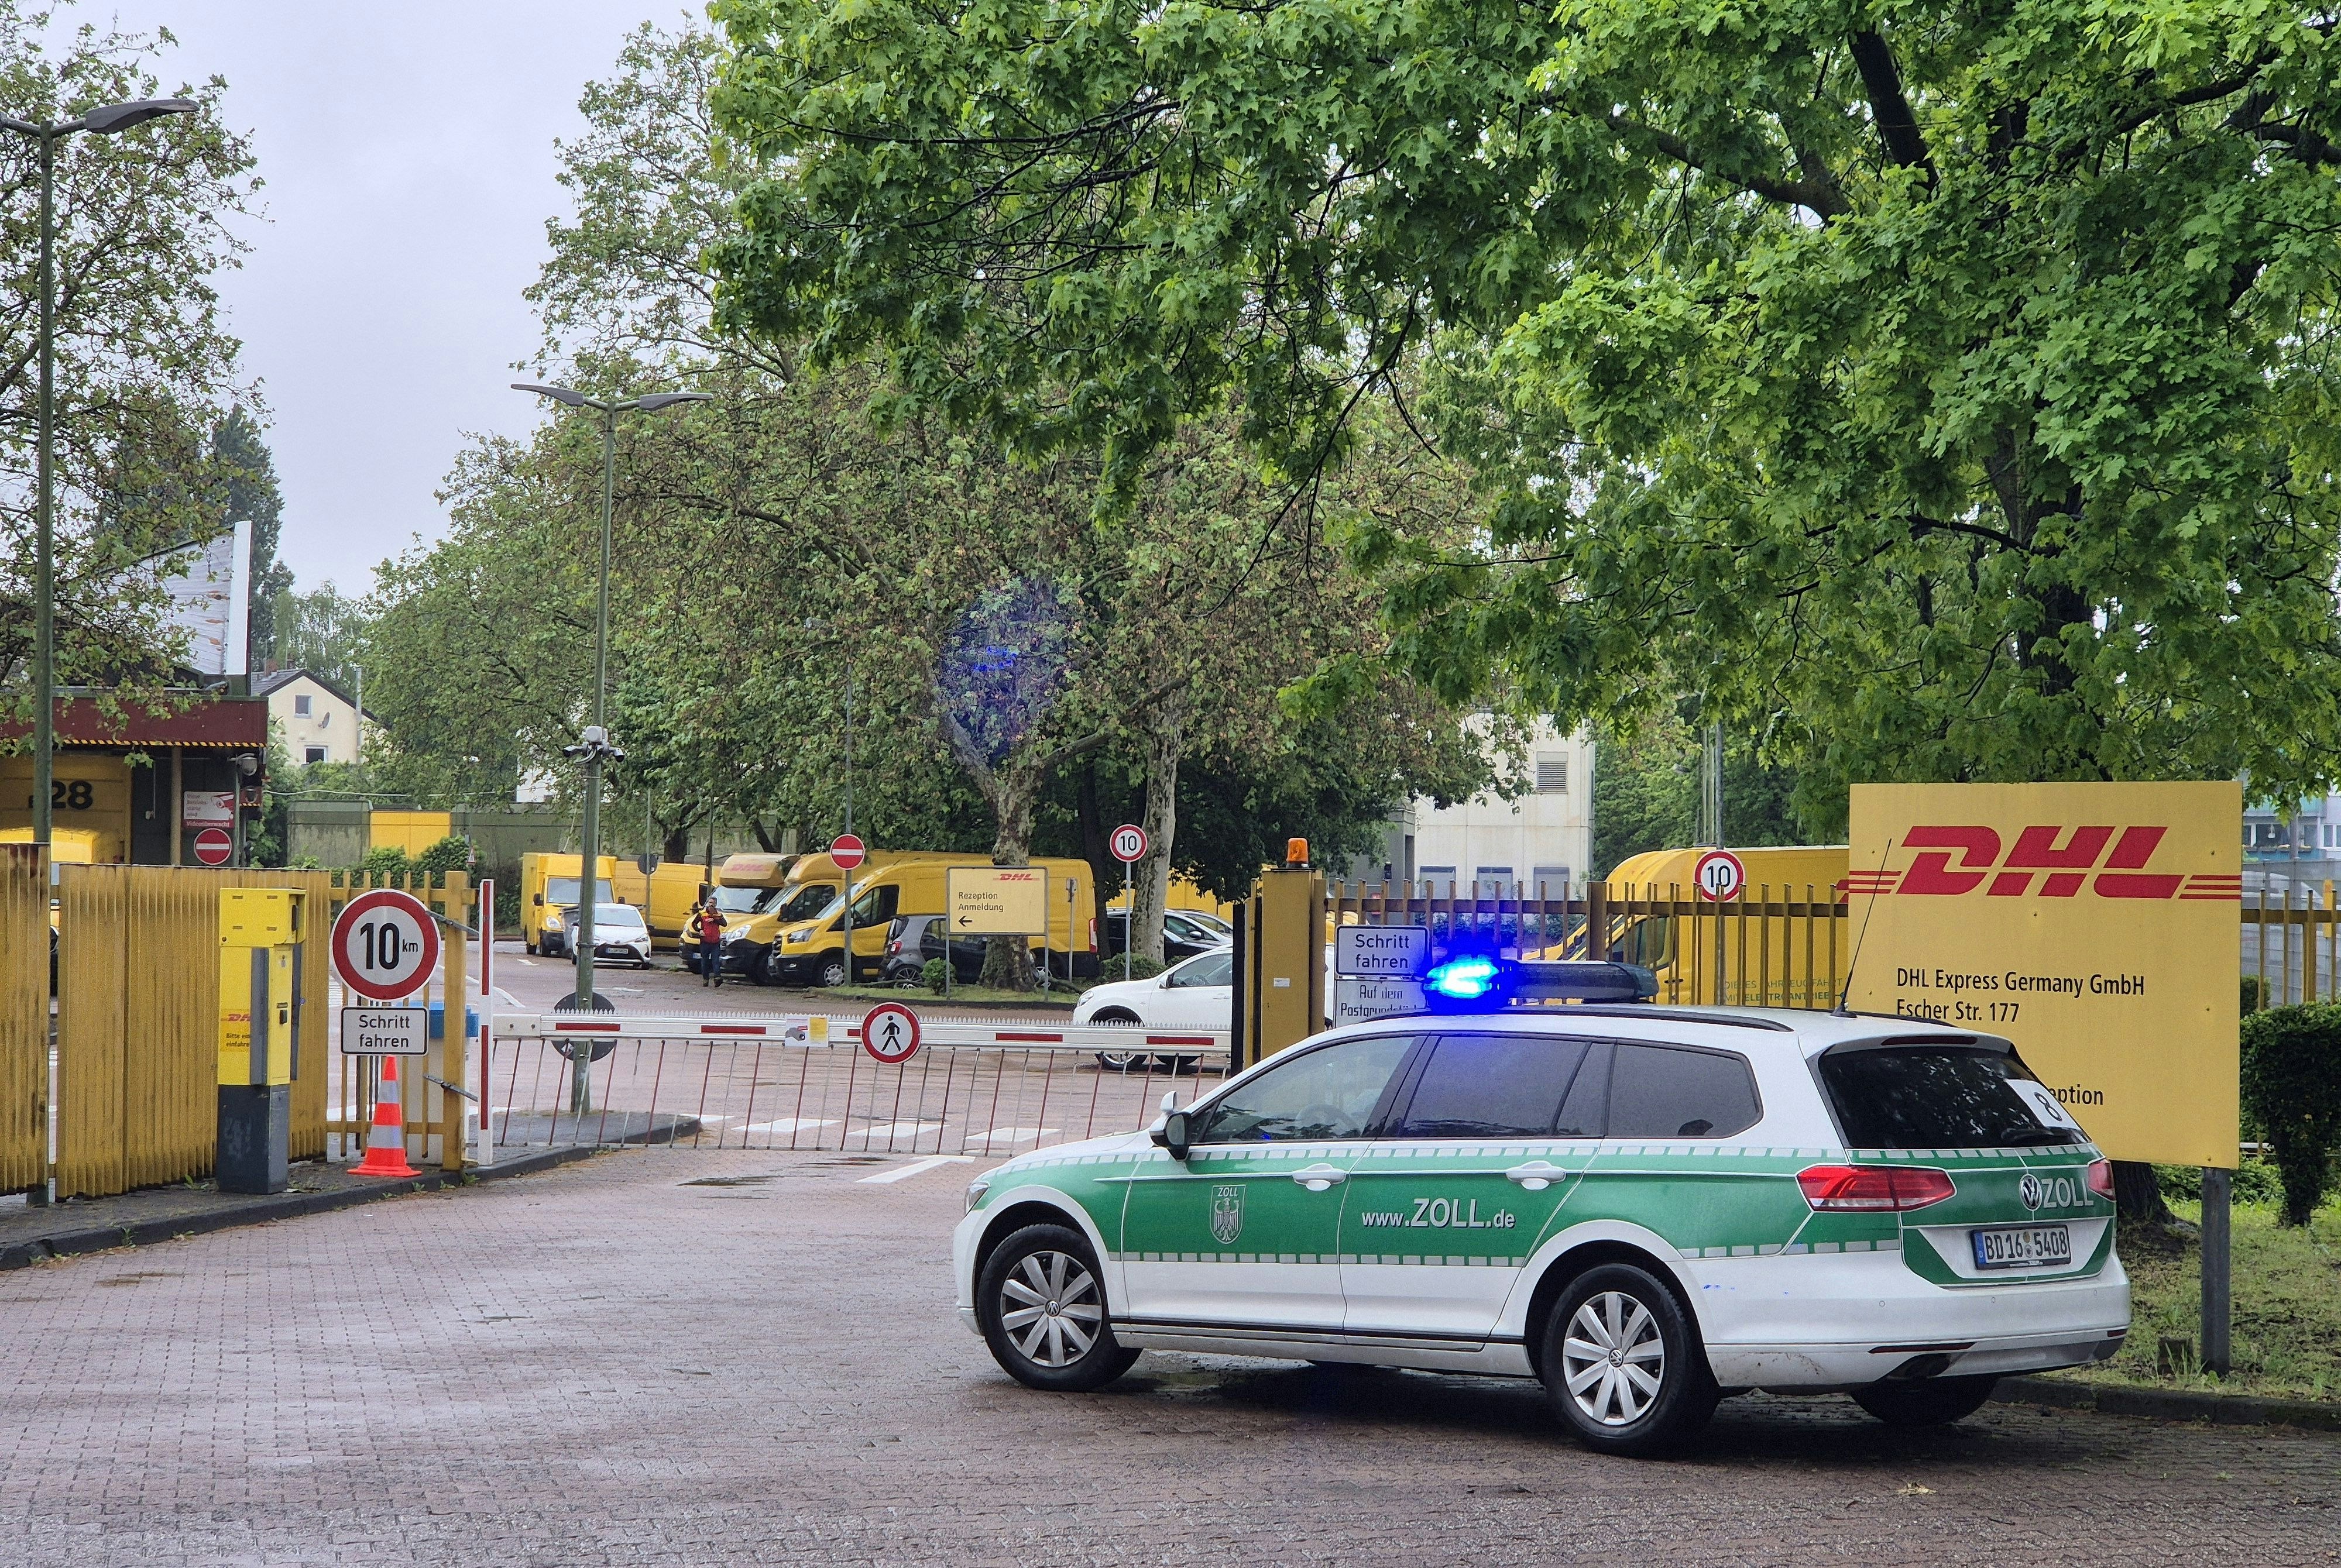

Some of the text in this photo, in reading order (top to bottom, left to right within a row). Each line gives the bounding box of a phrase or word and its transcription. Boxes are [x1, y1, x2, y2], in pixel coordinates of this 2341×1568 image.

[1120, 835, 1137, 851] 10
[1896, 826, 2185, 899] DHL
[1707, 865, 1731, 888] 10
[958, 891, 998, 901] Rezeption
[958, 903, 1004, 913] Anmeldung
[359, 923, 419, 970] 10 km
[1355, 934, 1410, 948] Schritt
[1355, 954, 1408, 968] fahren
[1725, 980, 1757, 989] DIEES
[1897, 967, 2144, 999] DHL Express Germany GmbH
[1360, 985, 1403, 999] Auf dem
[228, 1013, 251, 1022] DH
[1897, 998, 2020, 1023] Escher Str. 177
[358, 1014, 410, 1029] Schritt
[359, 1033, 409, 1047] fahren
[2048, 1084, 2104, 1105] eption
[2034, 1091, 2063, 1122] 8
[1217, 1187, 1238, 1197] ZOLL
[2041, 1177, 2094, 1208] ZOLL
[1361, 1198, 1516, 1228] www.ZOLL.de
[2033, 1230, 2068, 1257] 5408
